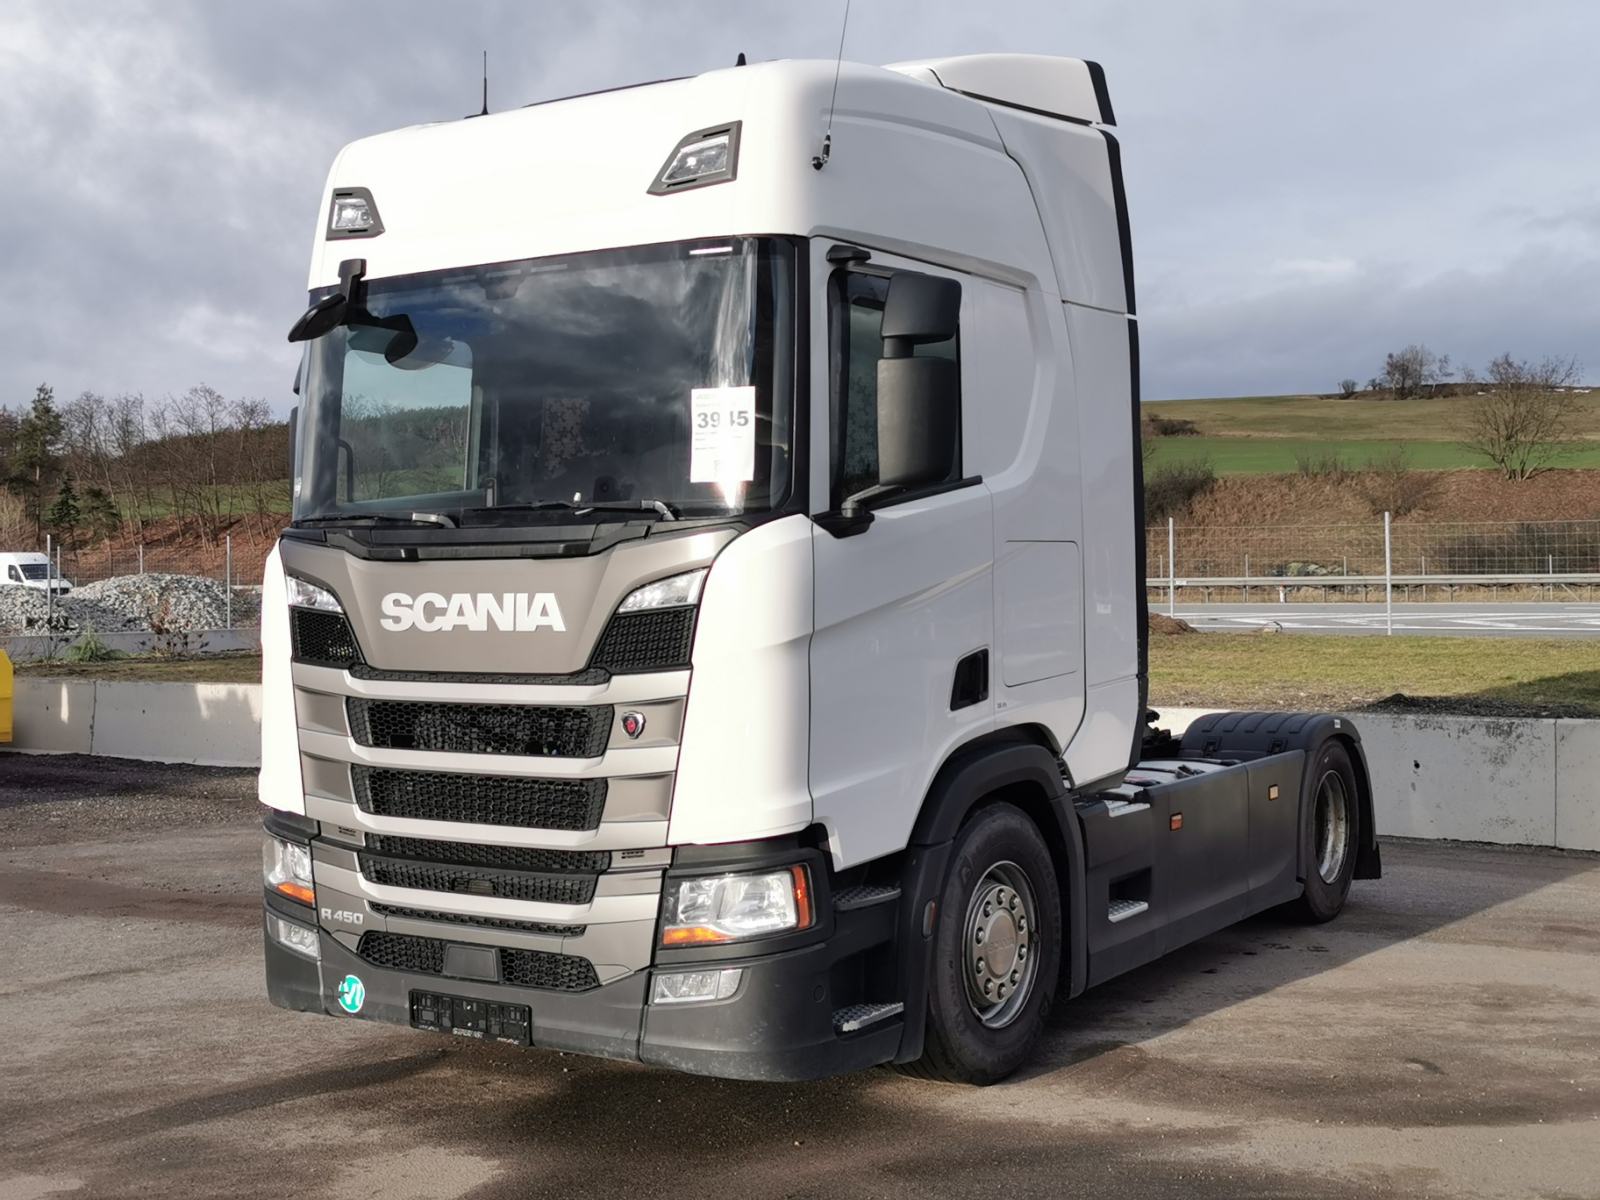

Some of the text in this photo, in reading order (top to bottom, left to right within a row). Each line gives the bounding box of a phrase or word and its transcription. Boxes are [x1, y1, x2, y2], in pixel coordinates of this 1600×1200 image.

[379, 592, 567, 632] SCANIA
[320, 908, 364, 925] R 450
